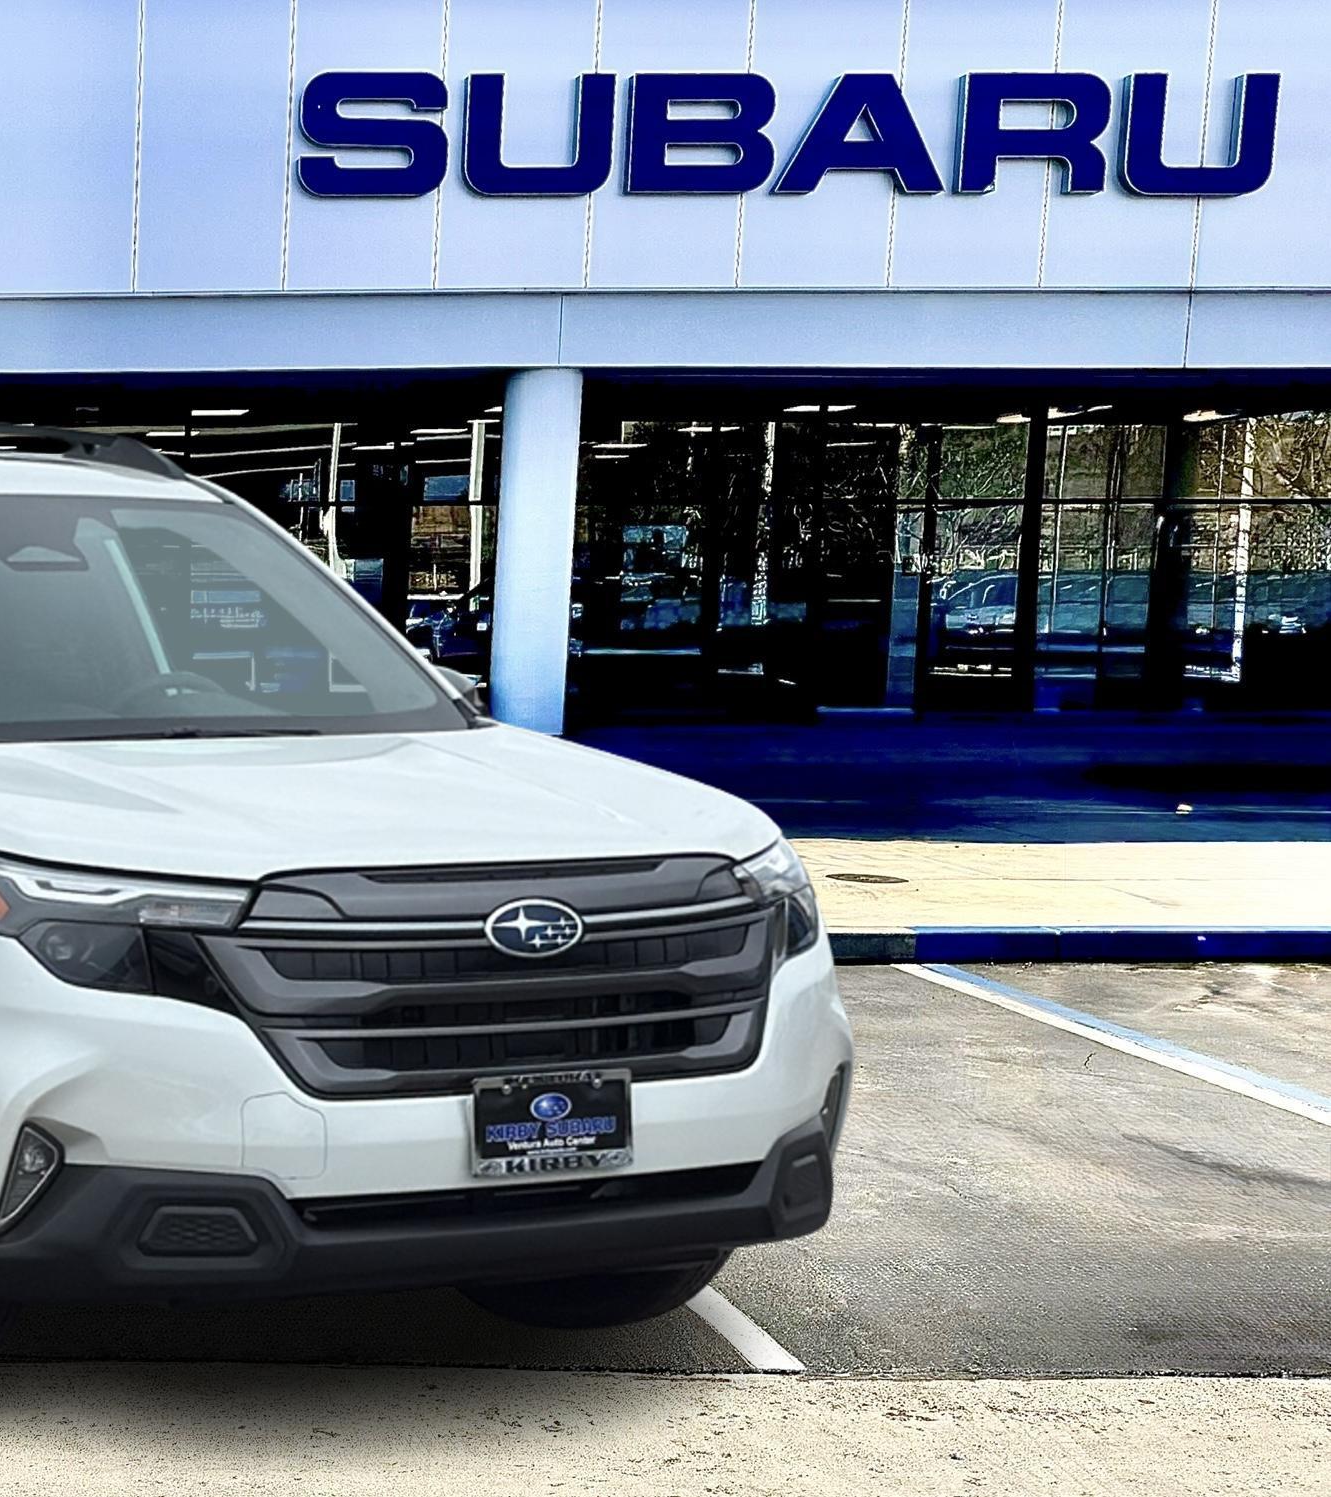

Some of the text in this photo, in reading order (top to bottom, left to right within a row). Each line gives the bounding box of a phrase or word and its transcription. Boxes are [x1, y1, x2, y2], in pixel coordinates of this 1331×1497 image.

[297, 72, 1281, 197] SUBARU
[486, 1116, 616, 1142] KIRBY SUBARU
[507, 1140, 542, 1151] Ventura
[543, 1138, 565, 1147] Auto
[566, 1135, 596, 1146] Center
[505, 1153, 605, 1174] KIRBY
